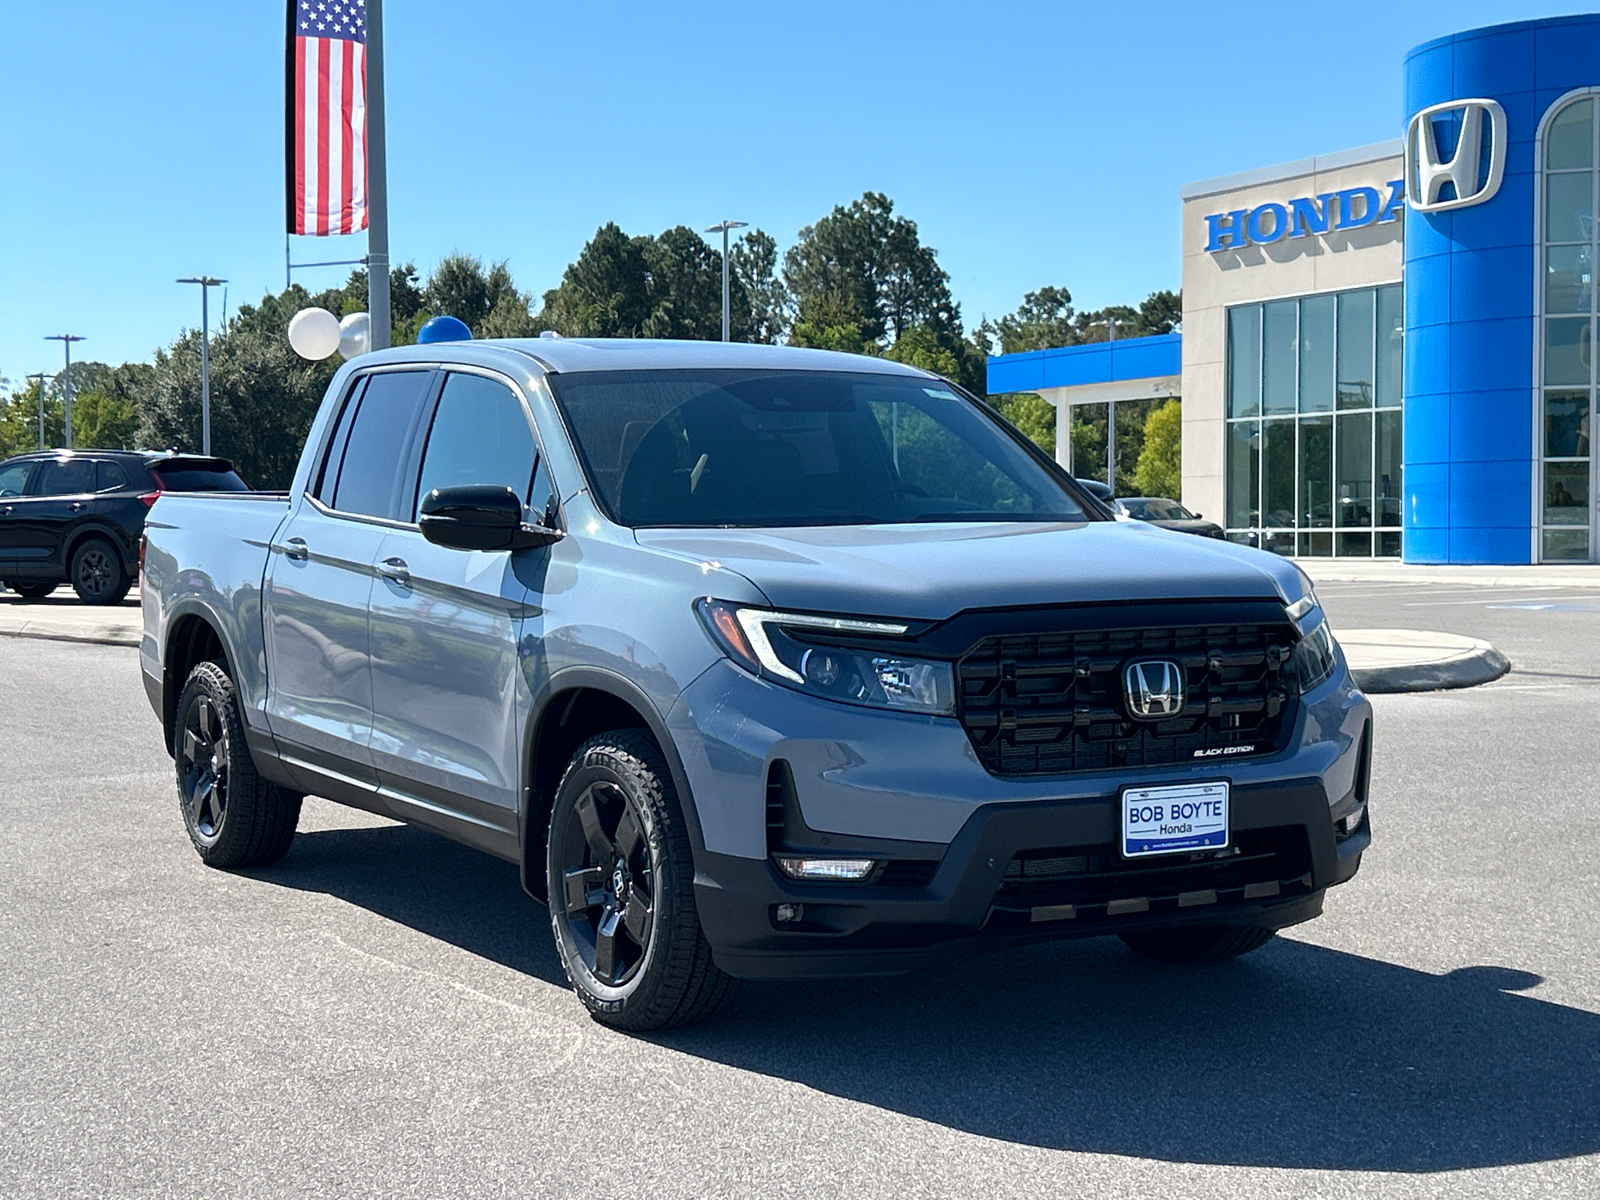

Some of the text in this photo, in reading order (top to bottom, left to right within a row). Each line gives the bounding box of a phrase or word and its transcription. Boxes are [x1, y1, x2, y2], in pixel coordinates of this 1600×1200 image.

[1193, 745, 1255, 757] BLACK EDITION
[1129, 800, 1222, 823] BOB BOYTE
[1160, 823, 1193, 835] Honda
